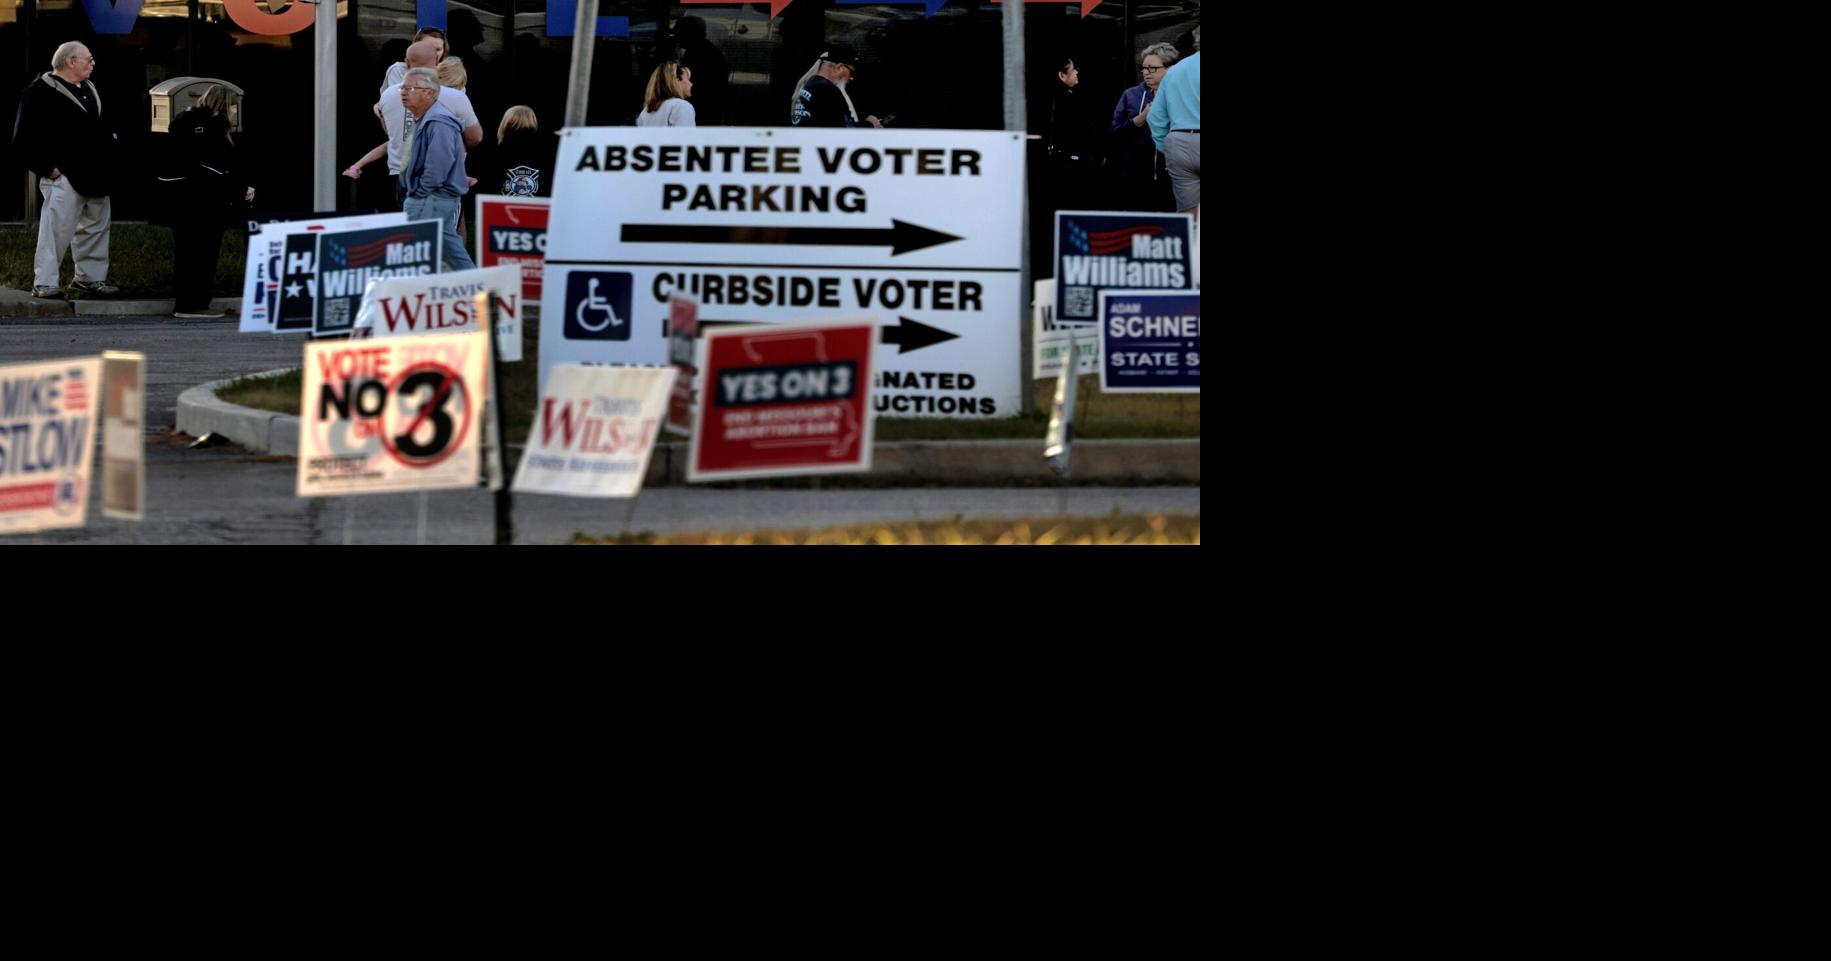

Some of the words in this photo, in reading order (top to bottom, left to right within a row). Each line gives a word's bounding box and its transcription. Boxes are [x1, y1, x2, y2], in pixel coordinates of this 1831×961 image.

[574, 145, 803, 175] ABSENTEE
[816, 147, 982, 176] VOTER
[661, 183, 868, 213] PARKING
[385, 240, 431, 266] Matt
[493, 230, 533, 250] YES
[1131, 233, 1184, 261] Matt
[287, 251, 317, 275] H
[1062, 255, 1186, 288] Williams
[430, 282, 484, 300] TRAVIS
[651, 272, 842, 308] CURBSIDE
[853, 278, 984, 311] VOTER
[379, 293, 518, 333] WILSN
[1109, 303, 1142, 315] ADAM
[1109, 315, 1200, 338] SCHNE
[318, 346, 390, 379] VOTE
[1110, 351, 1180, 367] STATE
[0, 373, 62, 419] MIKE
[721, 371, 777, 402] YES
[781, 367, 829, 398] ON
[832, 366, 851, 396] 3
[875, 371, 976, 391] NATED
[318, 379, 388, 421] NO
[395, 371, 455, 457] 3
